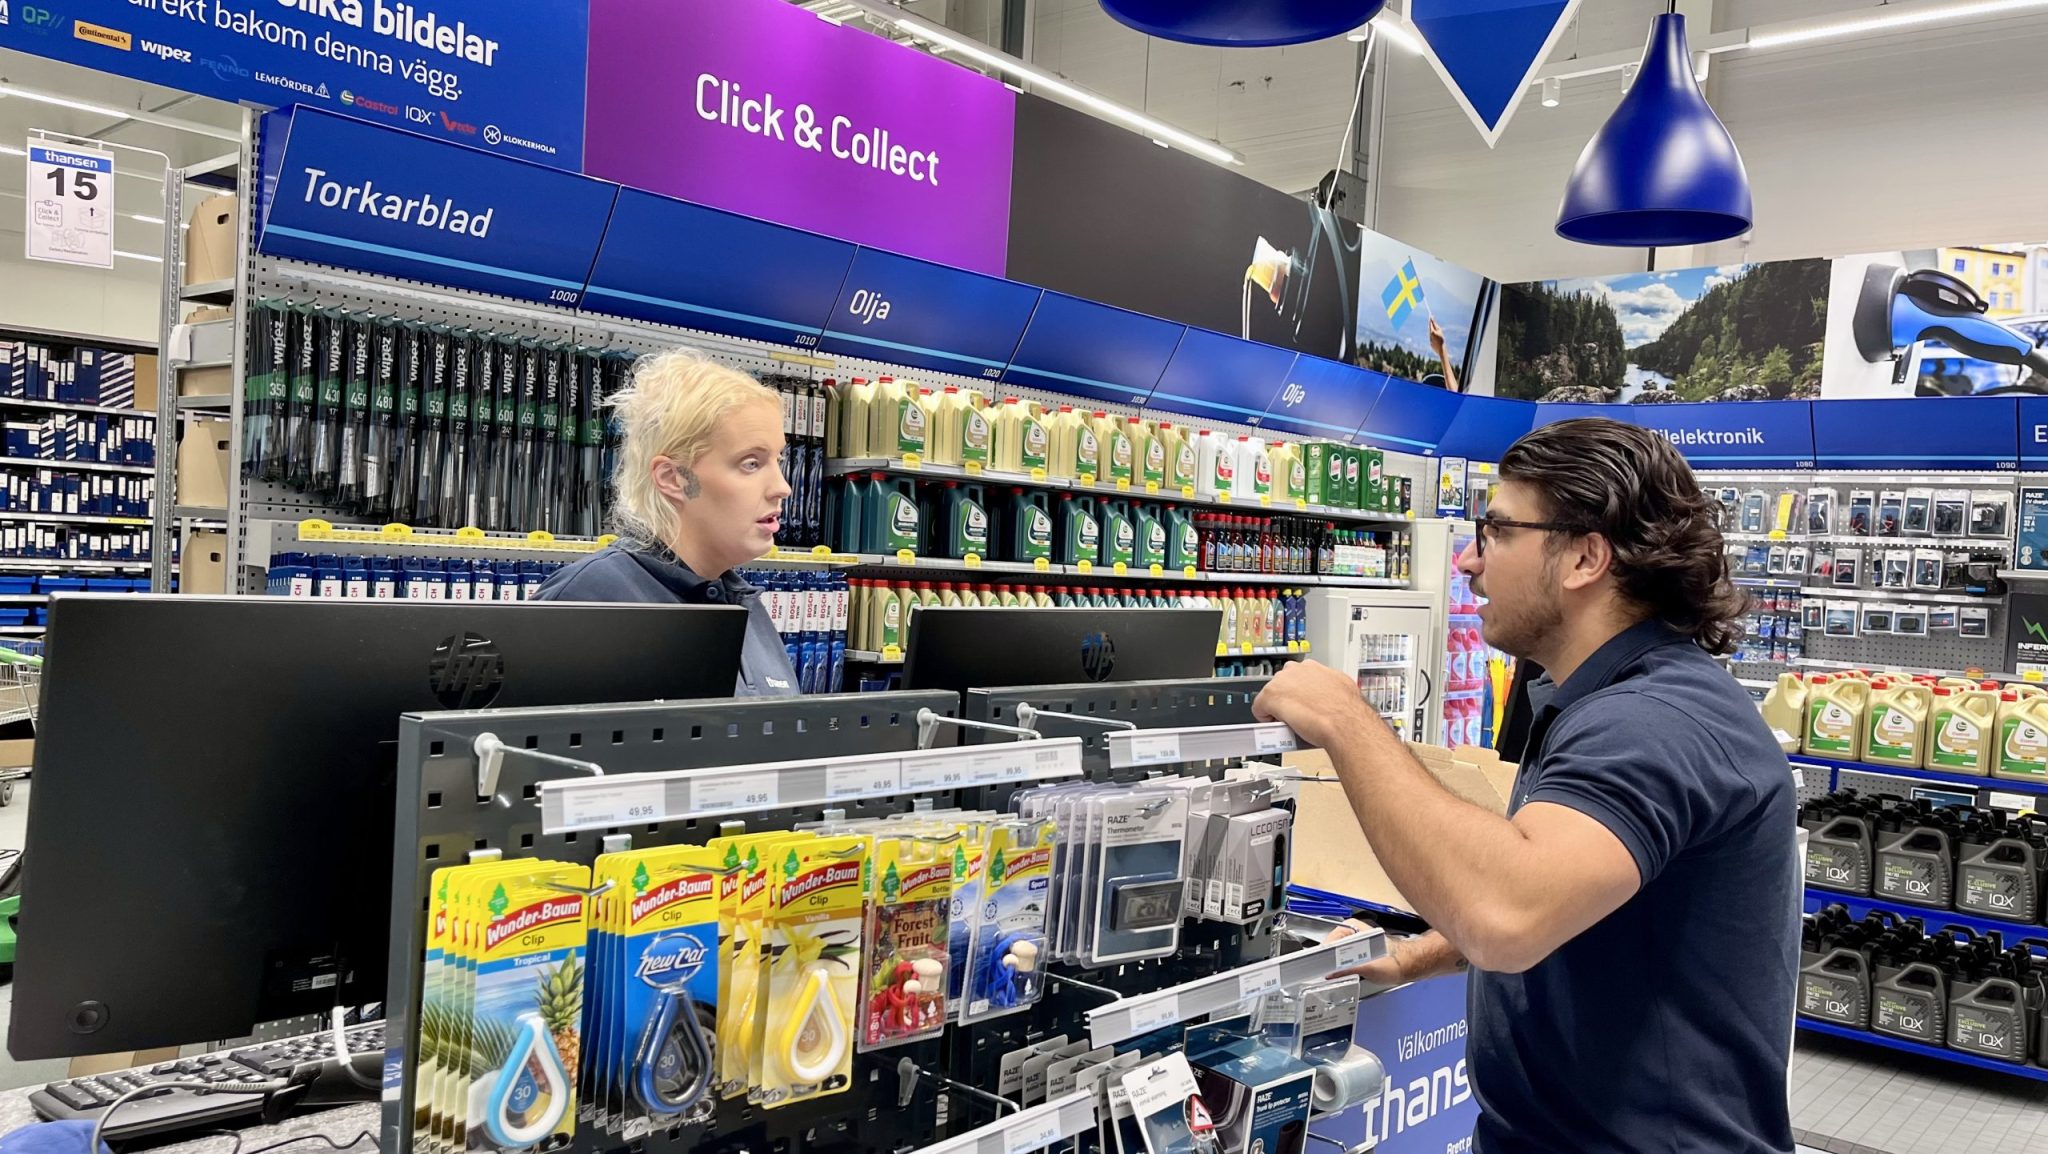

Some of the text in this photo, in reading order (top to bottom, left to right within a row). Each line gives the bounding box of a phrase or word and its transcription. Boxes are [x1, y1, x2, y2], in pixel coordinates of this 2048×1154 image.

[78, 25, 121, 43] Continental
[373, 0, 499, 66] bildelar
[140, 39, 192, 64] wipez
[214, 0, 307, 51] bakom
[314, 31, 392, 75] denna
[398, 57, 463, 102] vägg.
[255, 71, 313, 95] LEMFÖRDER
[355, 96, 398, 116] Castrol
[695, 72, 941, 186] Click & Collect
[503, 135, 556, 154] KLOKKERHOLM
[45, 150, 98, 169] thansen
[47, 167, 98, 201] 15
[303, 168, 493, 238] Torkarblad
[549, 291, 577, 304] 1000
[848, 288, 891, 325] Olja
[273, 320, 285, 365] wipez
[302, 324, 313, 368] wipez
[794, 334, 817, 346] 1010
[329, 328, 340, 372] wipez
[356, 333, 367, 375] wipez
[381, 336, 392, 379] wipez
[410, 340, 419, 382] wipez
[434, 342, 445, 385] wipez
[456, 347, 468, 389] wipez
[483, 350, 491, 391] wipez
[503, 353, 513, 394] wipez
[525, 356, 536, 397] wipez
[547, 359, 558, 399] wipez
[982, 367, 1001, 379] 1020
[269, 382, 286, 398] 350
[297, 386, 314, 401] 400
[569, 363, 578, 408] wipez
[350, 392, 367, 406] 450
[376, 395, 393, 409] 480
[1281, 383, 1305, 407] Olja
[429, 400, 444, 414] 530
[452, 402, 467, 417] 550
[498, 408, 513, 422] 600
[521, 410, 534, 424] 650
[543, 413, 557, 427] 700
[1795, 460, 1814, 469] 1080
[1995, 461, 2016, 470] 1090
[746, 793, 768, 803] 49,95
[629, 806, 653, 817] 49,95
[1107, 815, 1128, 825] RAZE
[901, 867, 950, 893] Wunder-Baum
[1825, 866, 1849, 881] IQX
[781, 866, 858, 903] Wunder-Baum
[1904, 879, 1930, 894] IQX
[632, 879, 712, 921] Wunder-Baum
[809, 895, 829, 906] Clip
[1988, 892, 2014, 908] IQX
[487, 900, 582, 946] Wunder-Baum
[662, 910, 682, 922] Clip
[894, 916, 934, 934] Forest
[522, 933, 545, 946] Clip
[898, 931, 930, 948] Fruit
[513, 953, 551, 968] Tropical
[1825, 999, 1849, 1014] IQX
[1899, 1016, 1923, 1031] IQX
[801, 1032, 816, 1042] 30
[1978, 1033, 2004, 1048] IQX
[660, 1054, 675, 1068] 30
[514, 1085, 531, 1101] 30
[1362, 1058, 1473, 1145] thans
